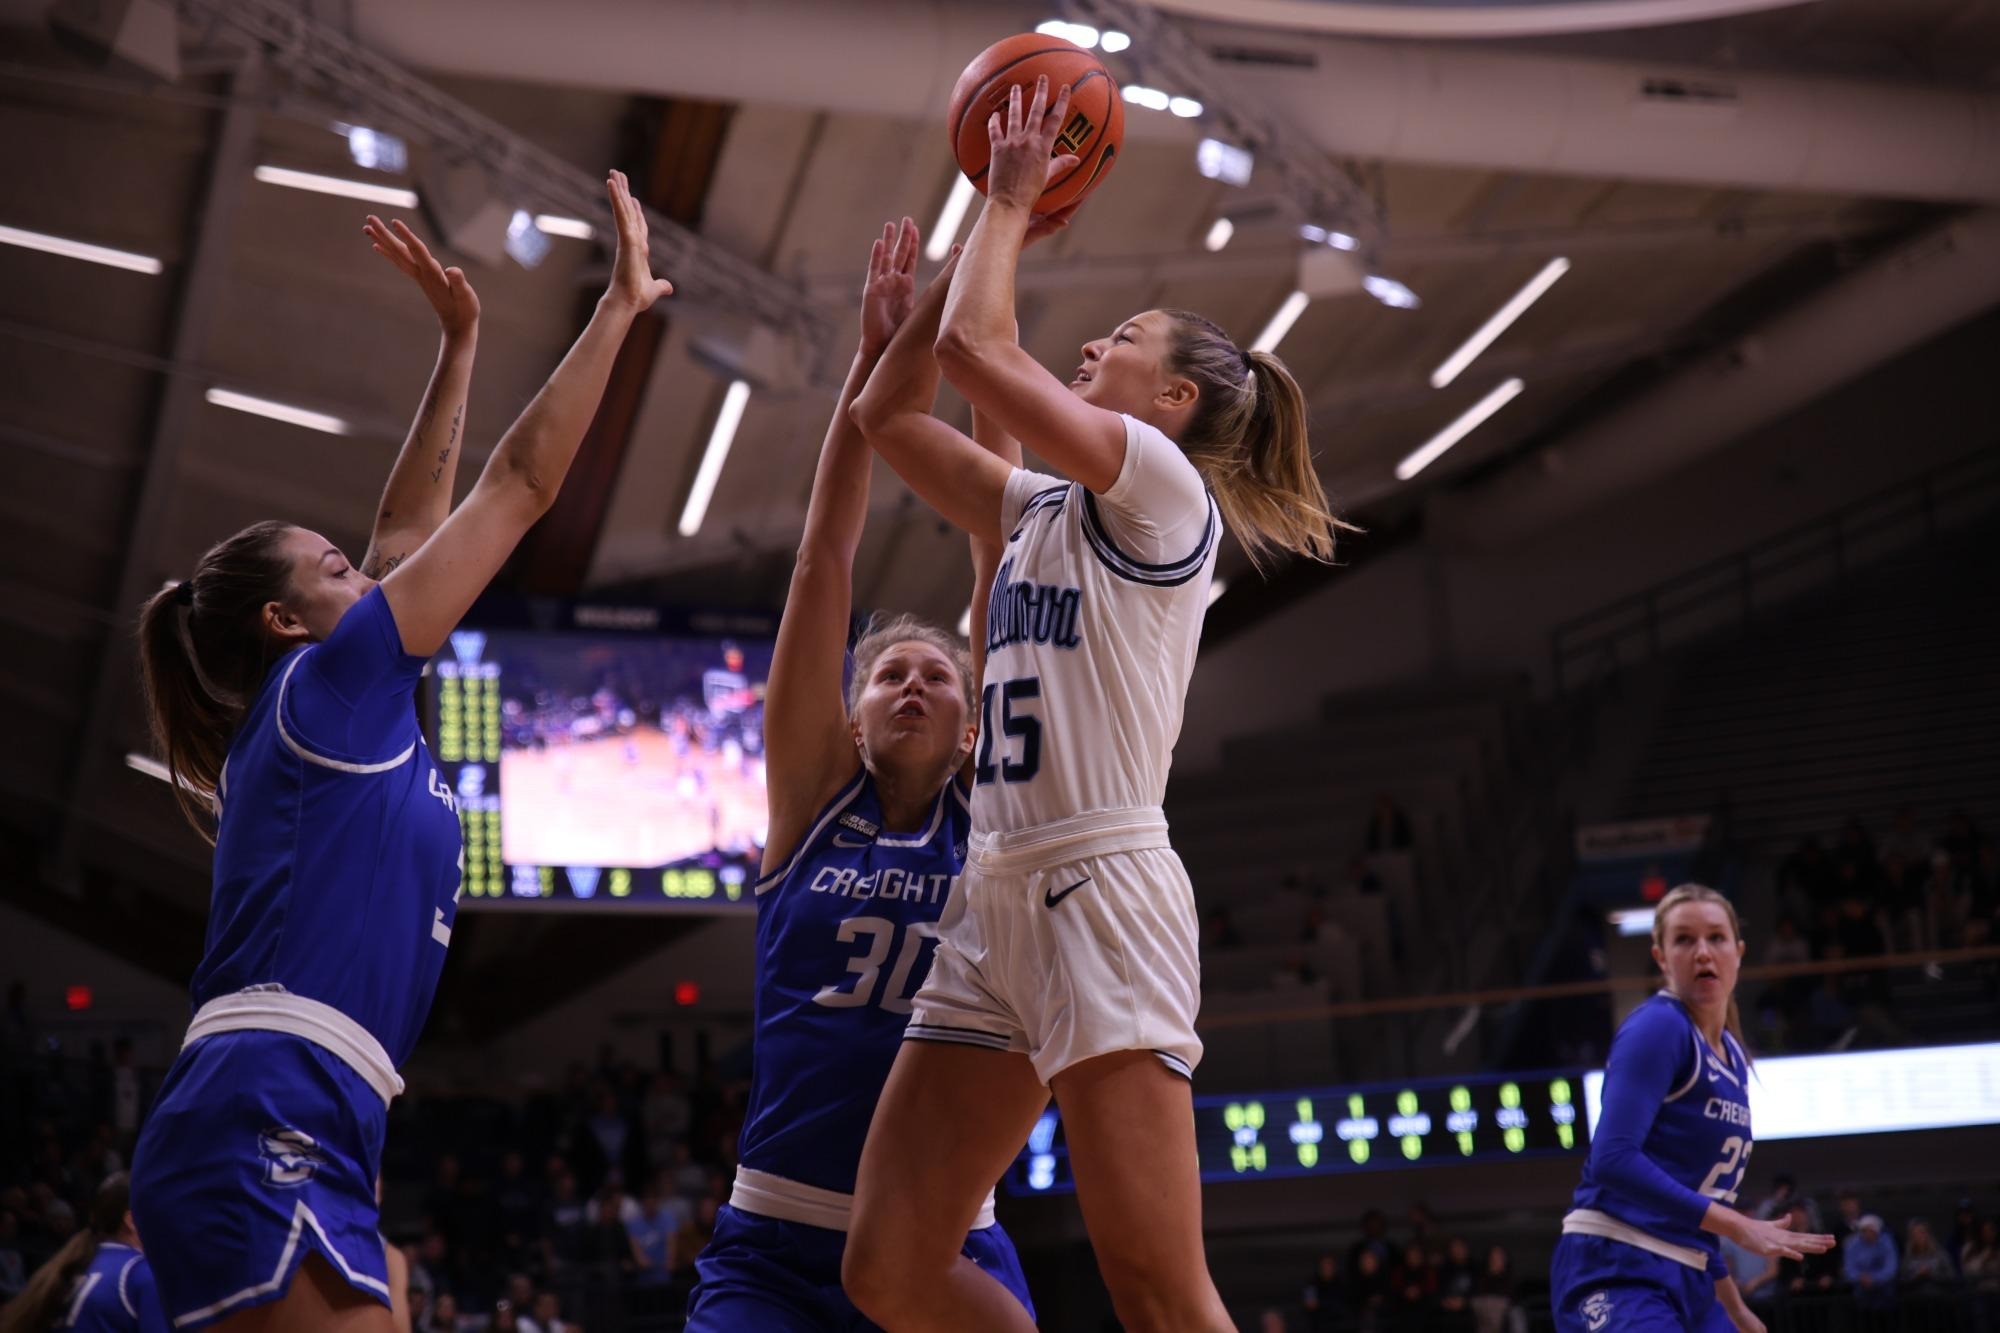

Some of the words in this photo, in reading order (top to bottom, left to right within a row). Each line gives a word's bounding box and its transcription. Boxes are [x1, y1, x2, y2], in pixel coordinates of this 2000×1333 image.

[975, 676, 1042, 787] 15
[810, 866, 957, 904] CREIGHT
[811, 916, 939, 1015] 30
